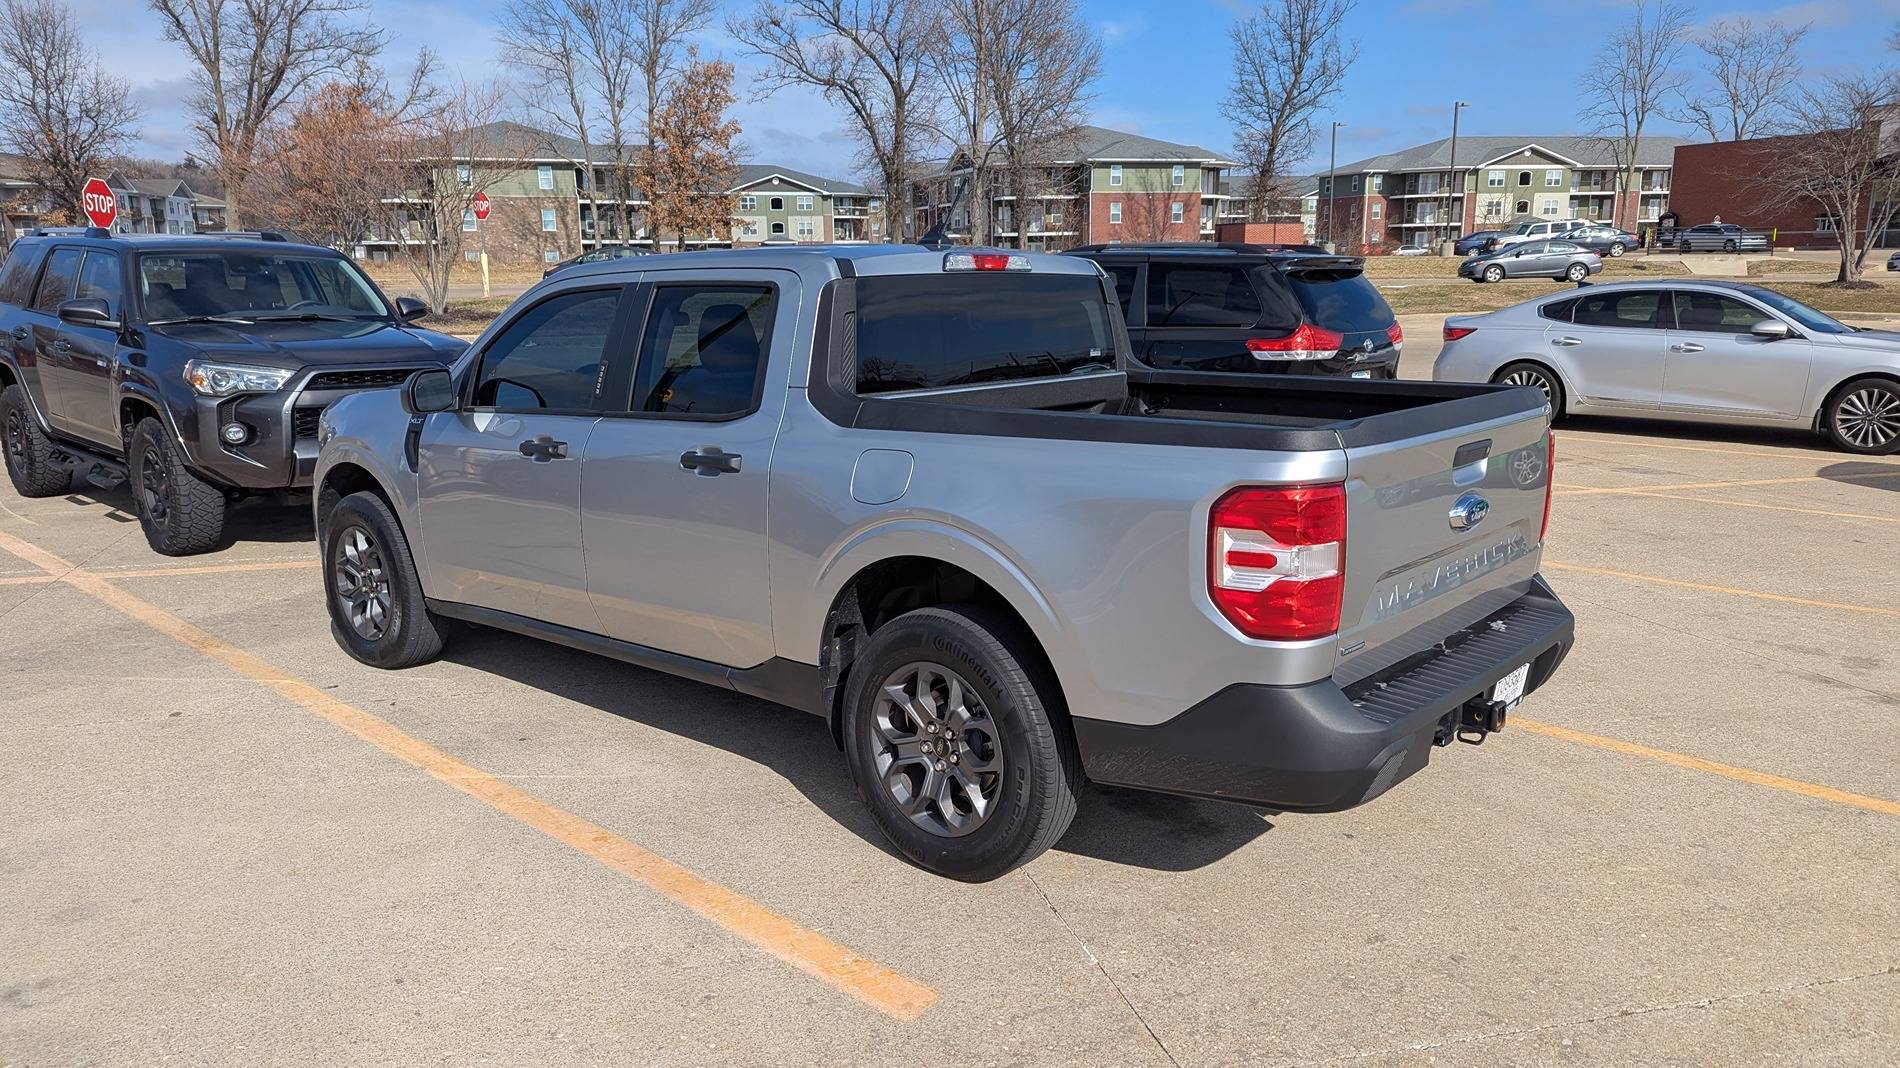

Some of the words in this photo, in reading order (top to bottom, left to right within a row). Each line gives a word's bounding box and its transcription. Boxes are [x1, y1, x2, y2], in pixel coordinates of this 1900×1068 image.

[85, 192, 114, 214] STOP
[1377, 532, 1520, 610] MAVERICK
[932, 635, 998, 690] Continental
